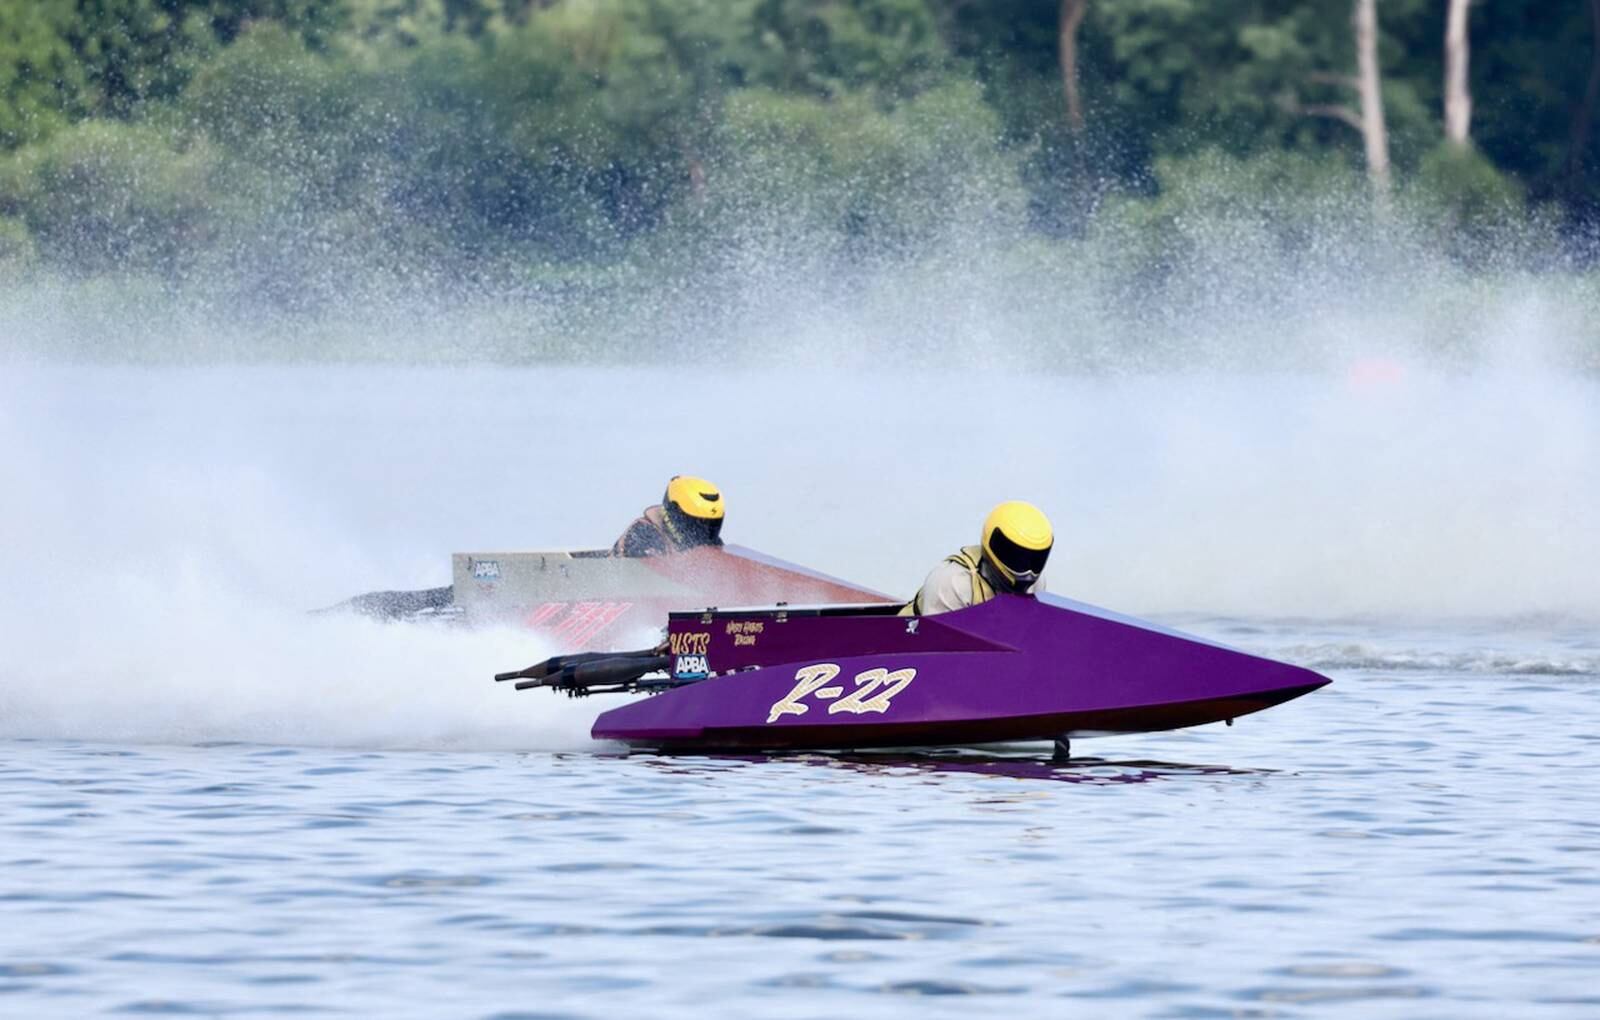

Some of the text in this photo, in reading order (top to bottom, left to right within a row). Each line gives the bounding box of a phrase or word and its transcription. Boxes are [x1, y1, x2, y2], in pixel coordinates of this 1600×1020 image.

[475, 562, 499, 577] APBA
[670, 632, 710, 655] USTS
[676, 656, 709, 674] APBA
[766, 663, 917, 723] R-22
